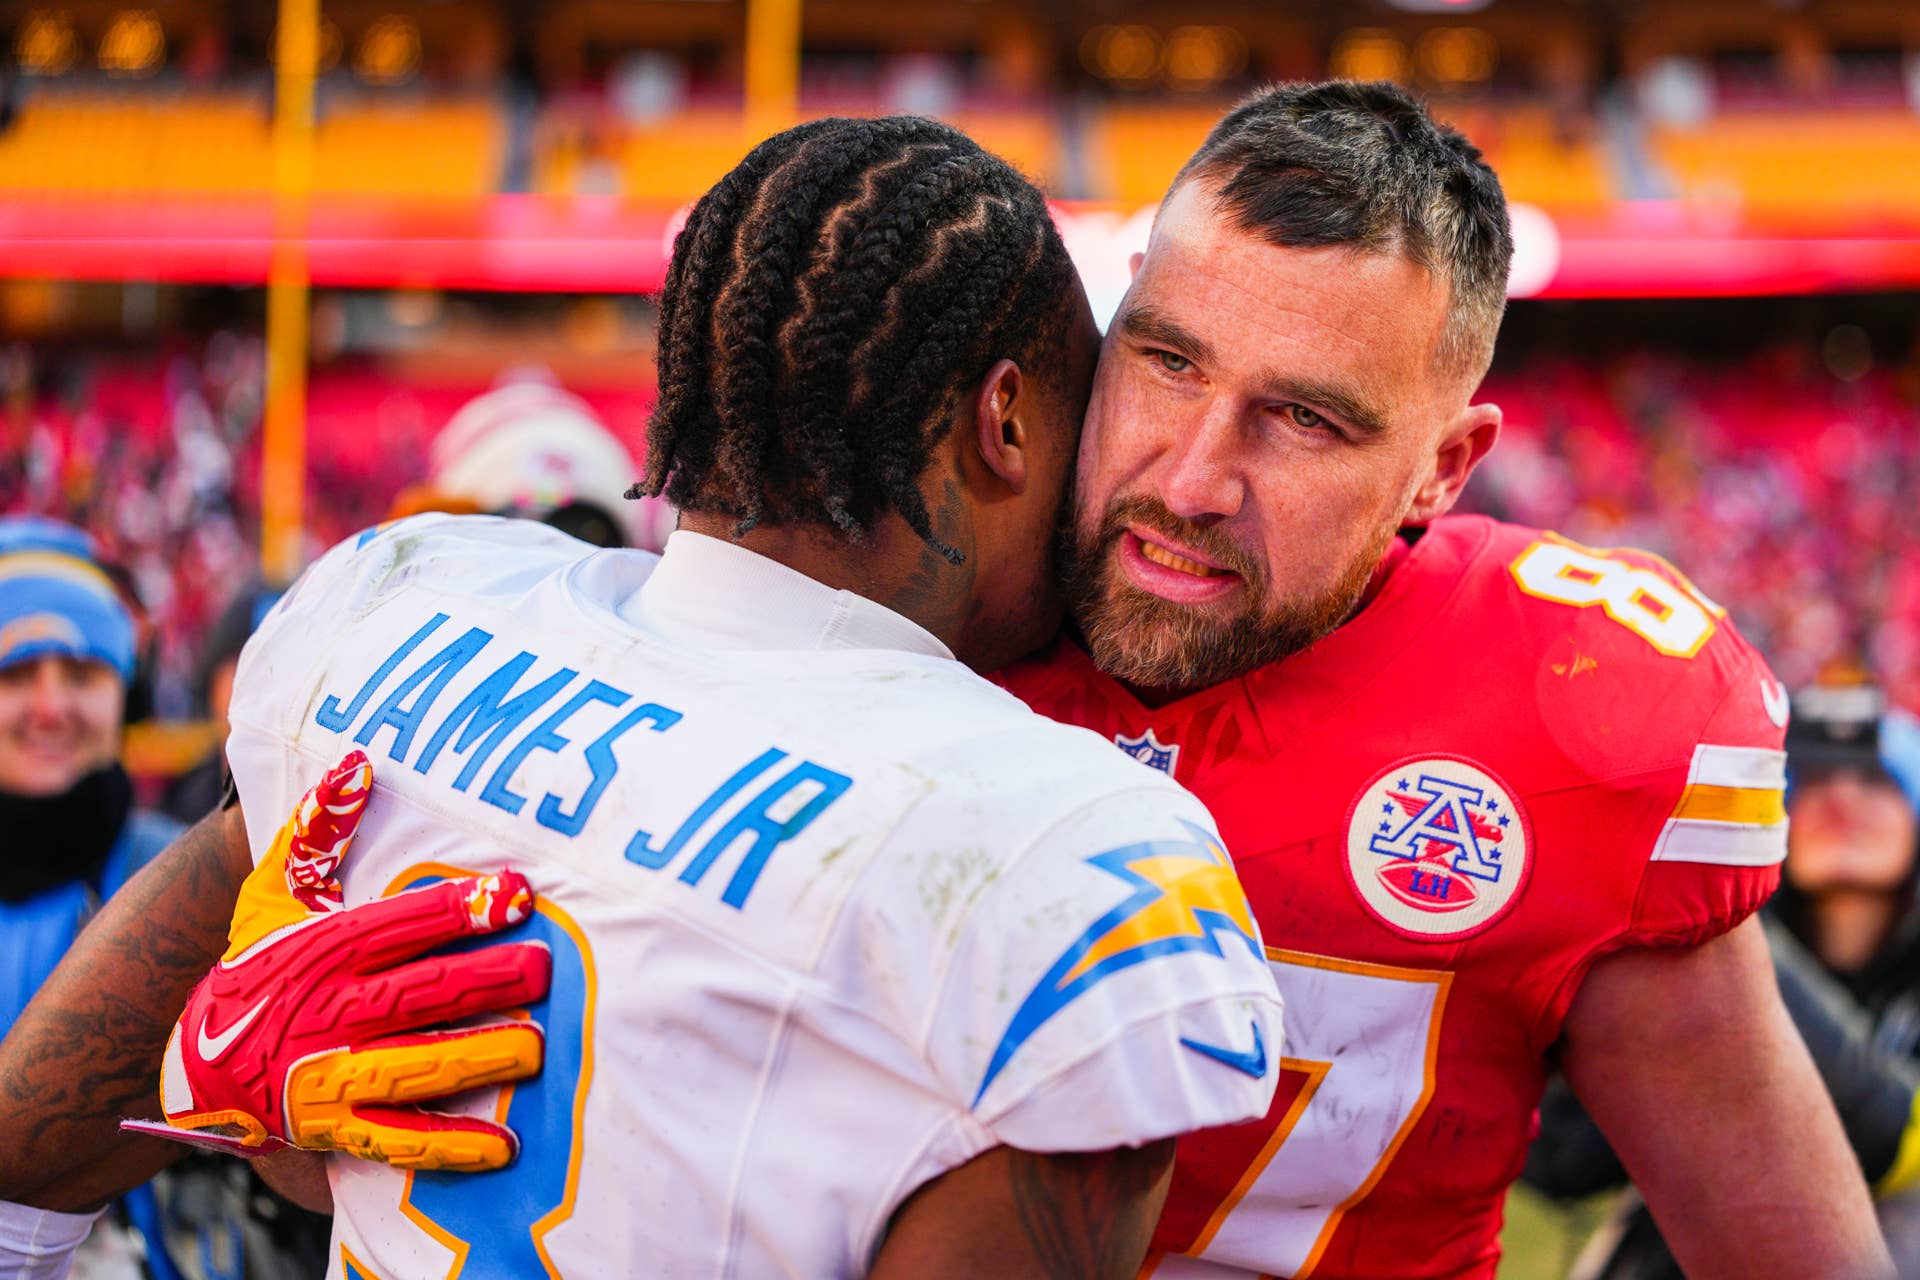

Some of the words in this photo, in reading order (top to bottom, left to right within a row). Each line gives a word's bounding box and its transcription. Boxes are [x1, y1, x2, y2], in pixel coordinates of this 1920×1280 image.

[1509, 530, 1727, 659] 8
[316, 613, 683, 837] JAMES
[625, 747, 853, 910] JR
[1368, 774, 1502, 883] A
[1409, 870, 1451, 899] LH
